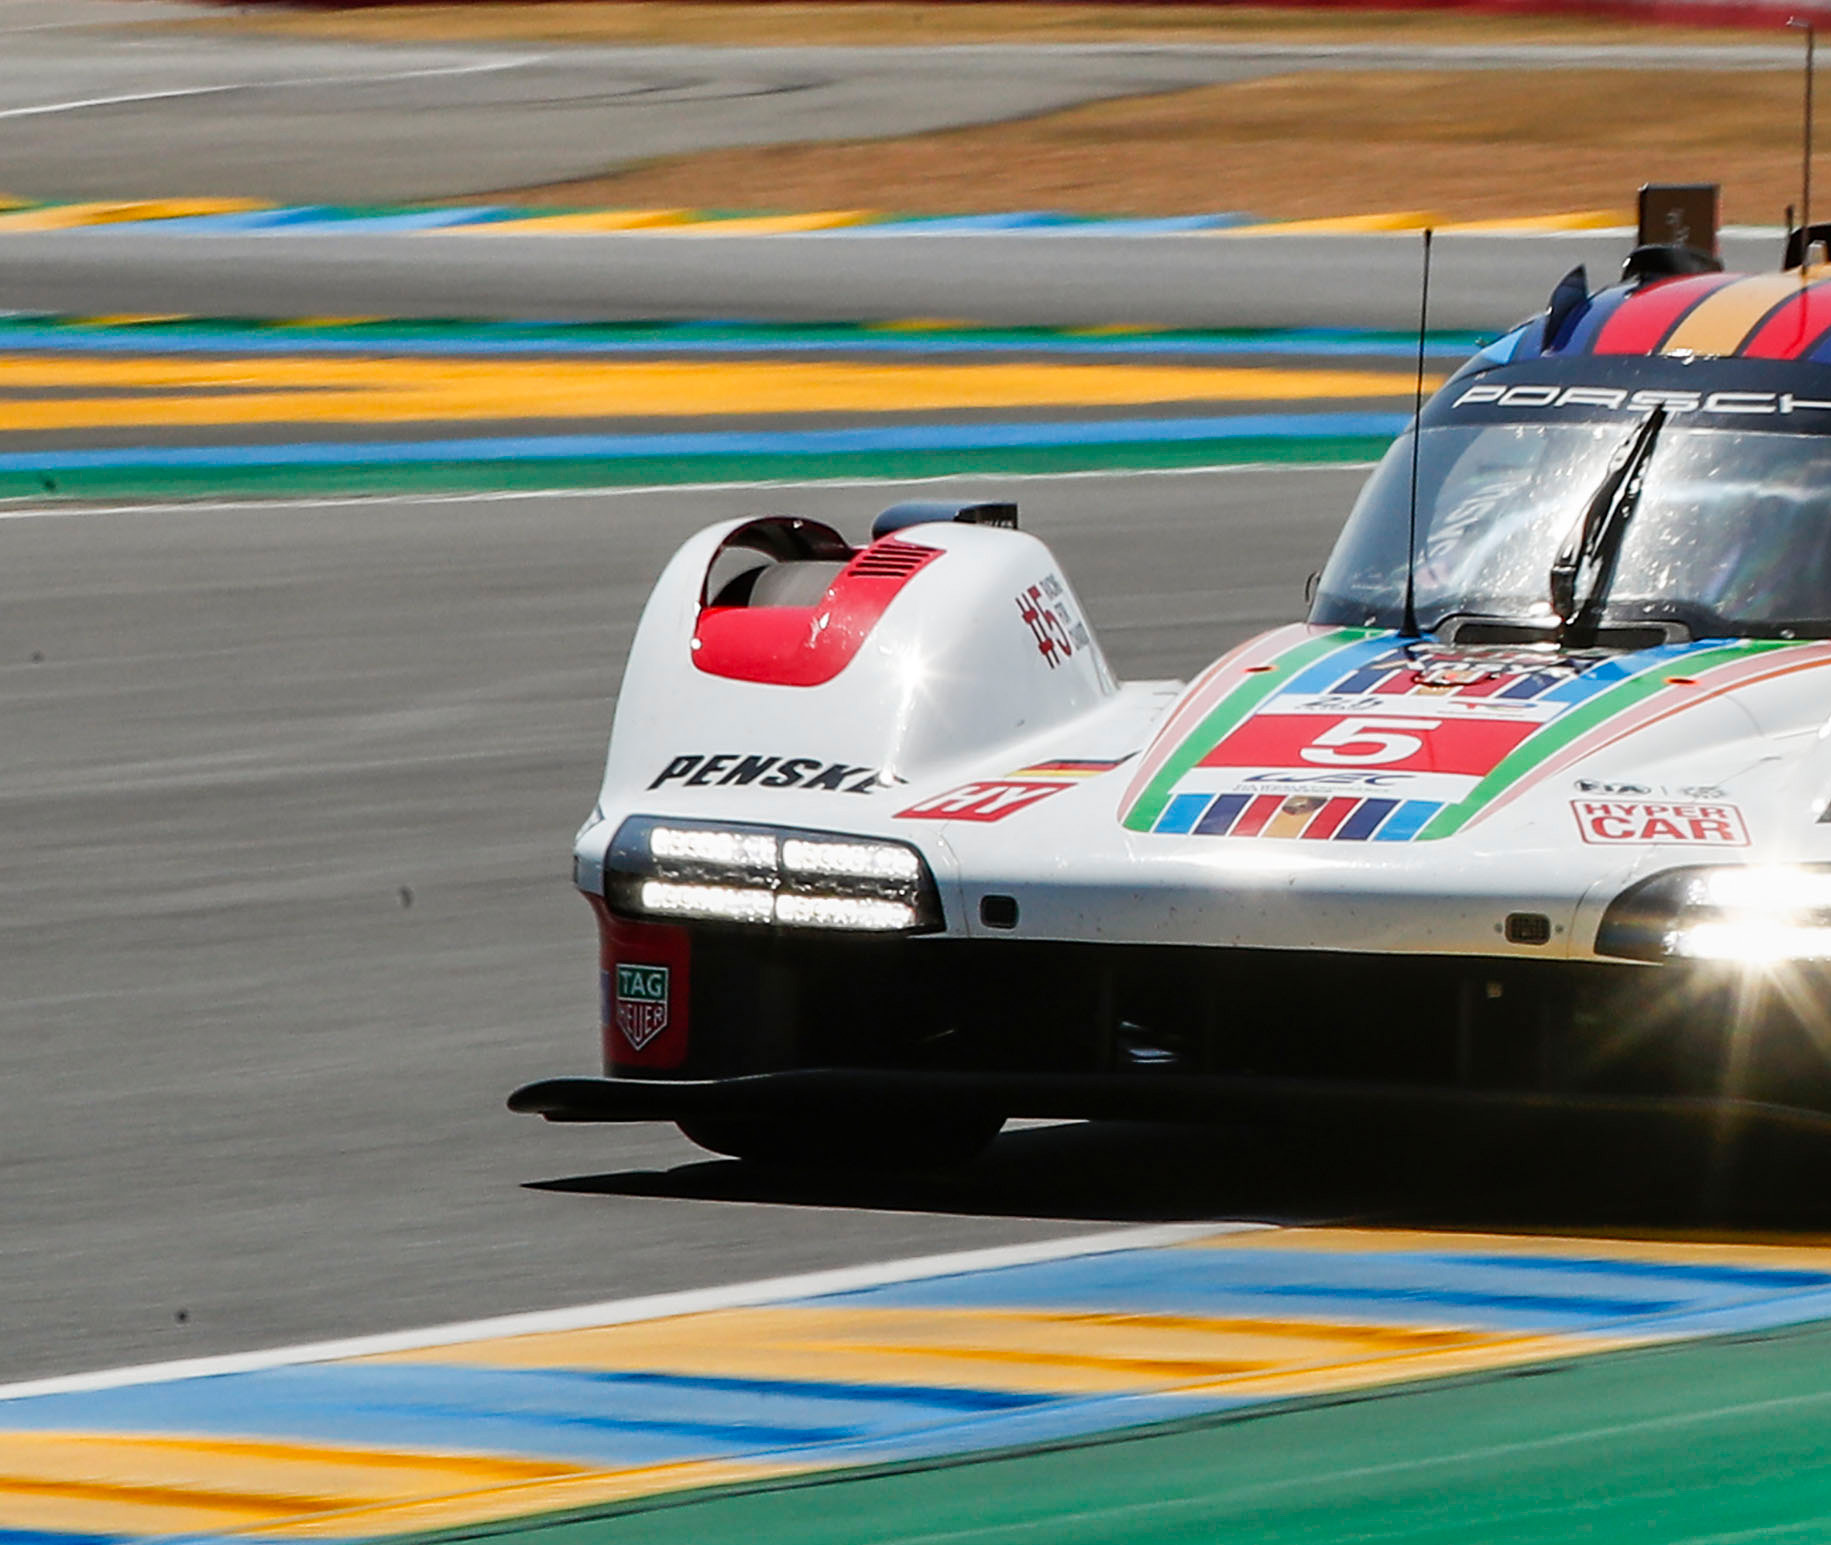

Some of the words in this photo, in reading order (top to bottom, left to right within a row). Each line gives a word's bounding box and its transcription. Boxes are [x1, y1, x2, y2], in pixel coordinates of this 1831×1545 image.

[1300, 718, 1443, 765] 5
[911, 785, 1061, 814] HY
[1583, 803, 1729, 819] HYPER
[1590, 816, 1738, 840] CAR
[619, 970, 663, 997] TAG
[616, 1002, 664, 1042] HEUER
